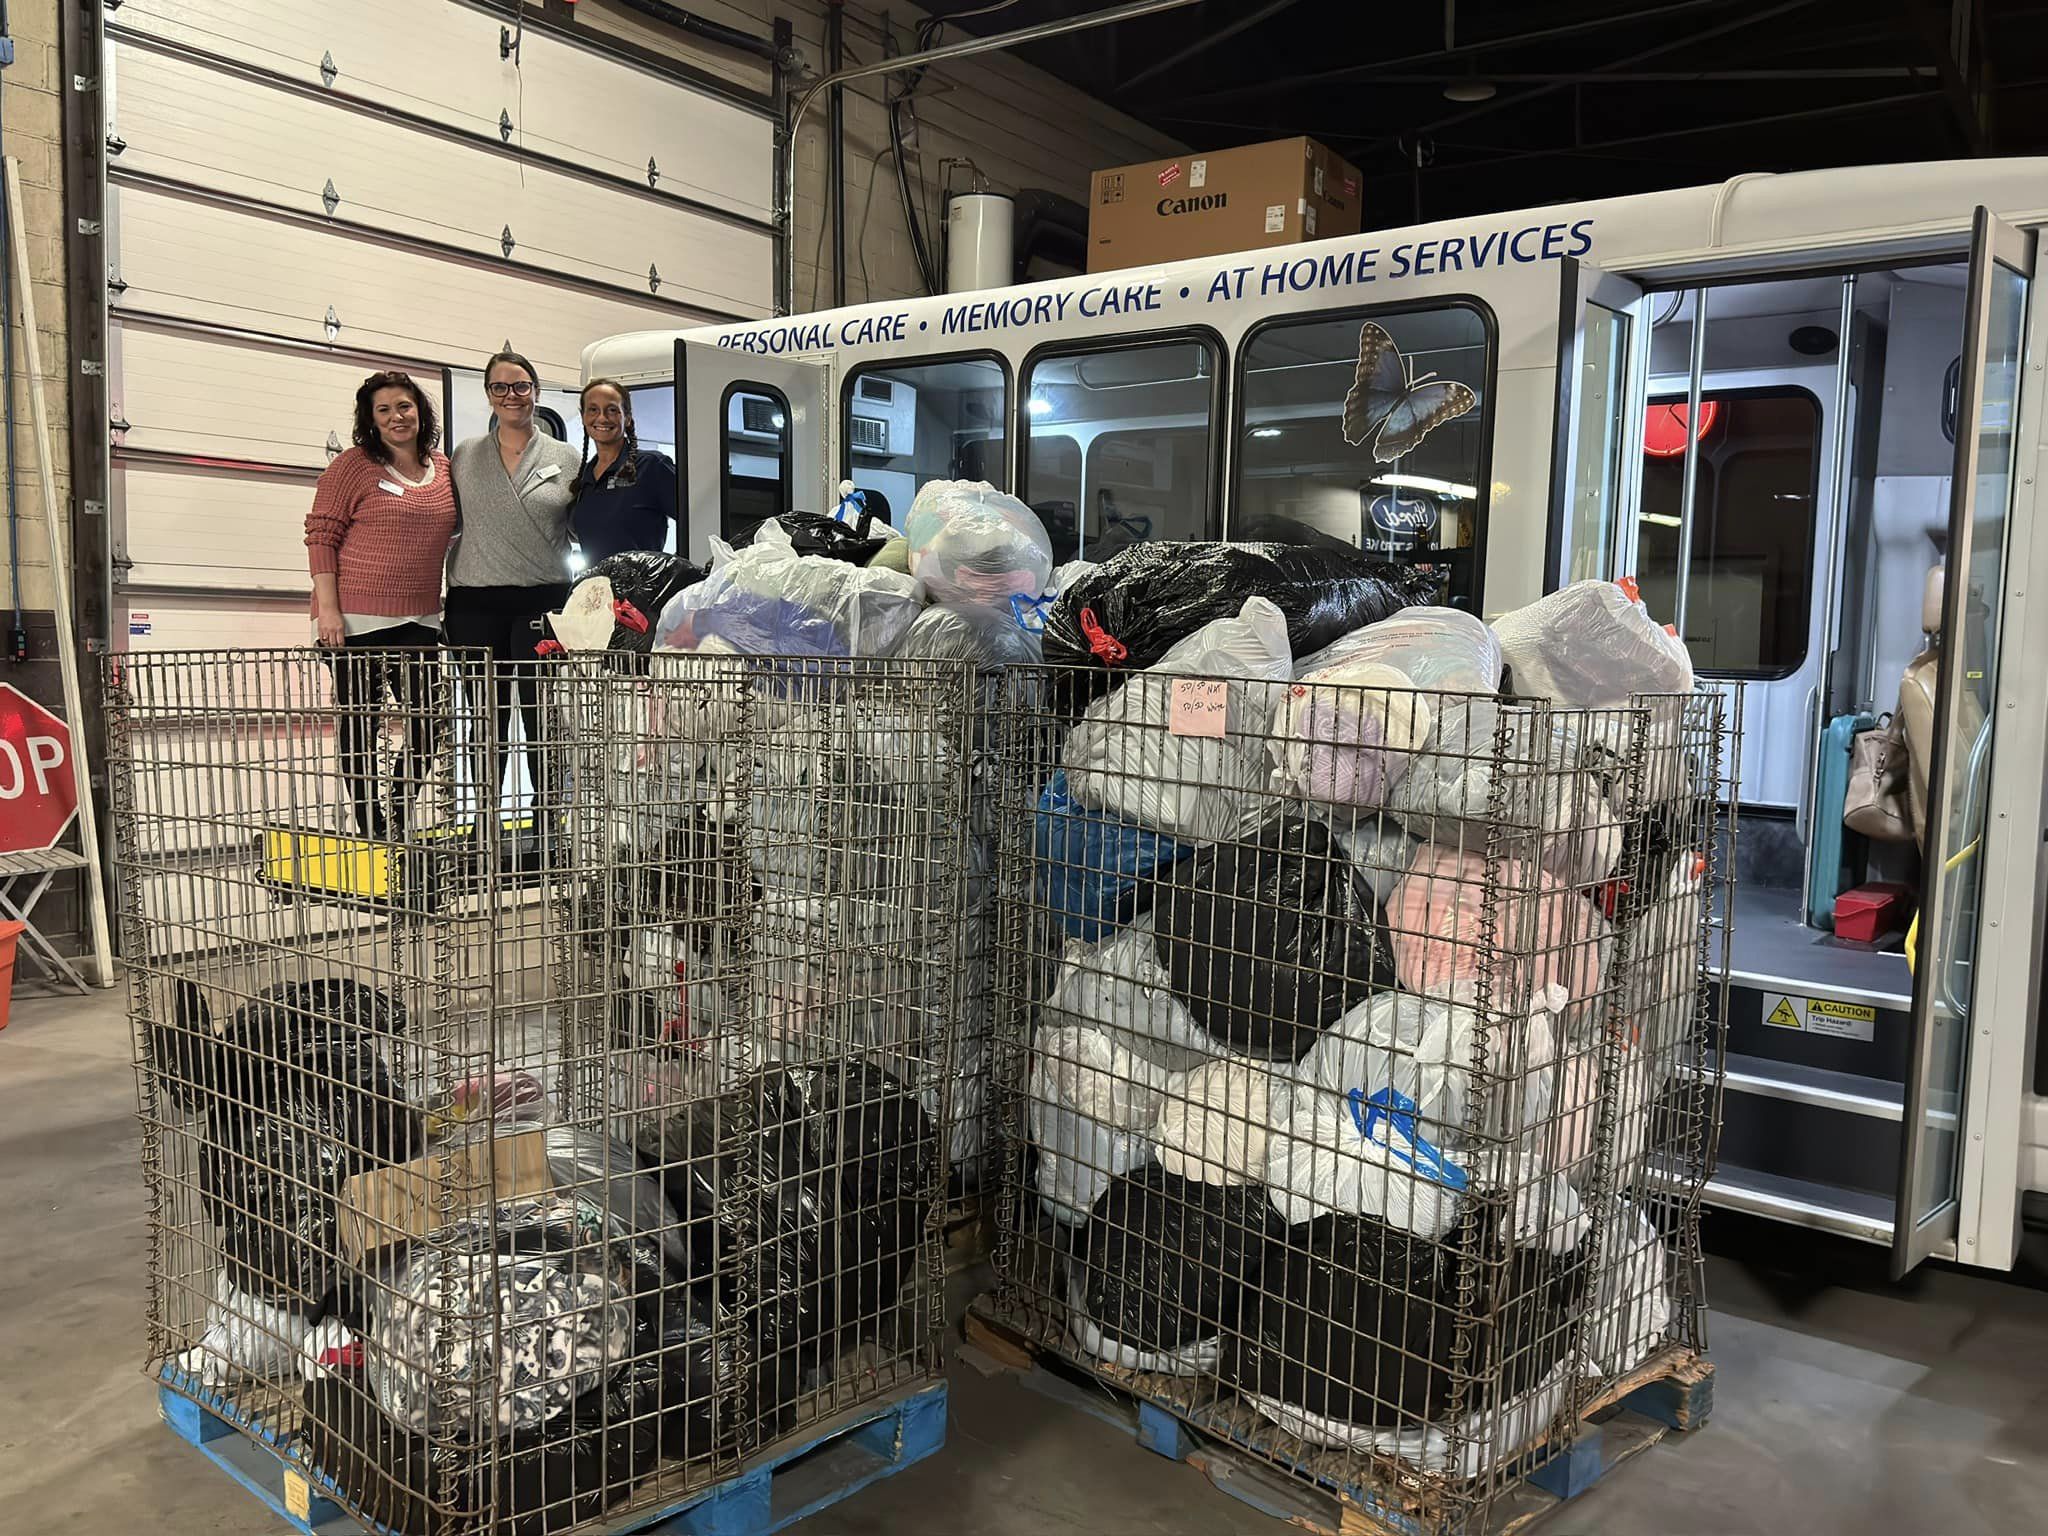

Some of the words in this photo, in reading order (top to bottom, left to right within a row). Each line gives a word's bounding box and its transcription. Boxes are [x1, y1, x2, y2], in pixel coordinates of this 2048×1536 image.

[1156, 192, 1227, 216] Canon
[840, 313, 909, 346] CARE
[941, 291, 1074, 335] MEMORY
[1078, 284, 1162, 318] CARE
[1206, 267, 1254, 303] AT
[1260, 248, 1381, 296] HOME
[1389, 219, 1594, 279] SERVICES
[0, 735, 65, 800] OP
[1823, 1003, 1871, 1018] CAUTION
